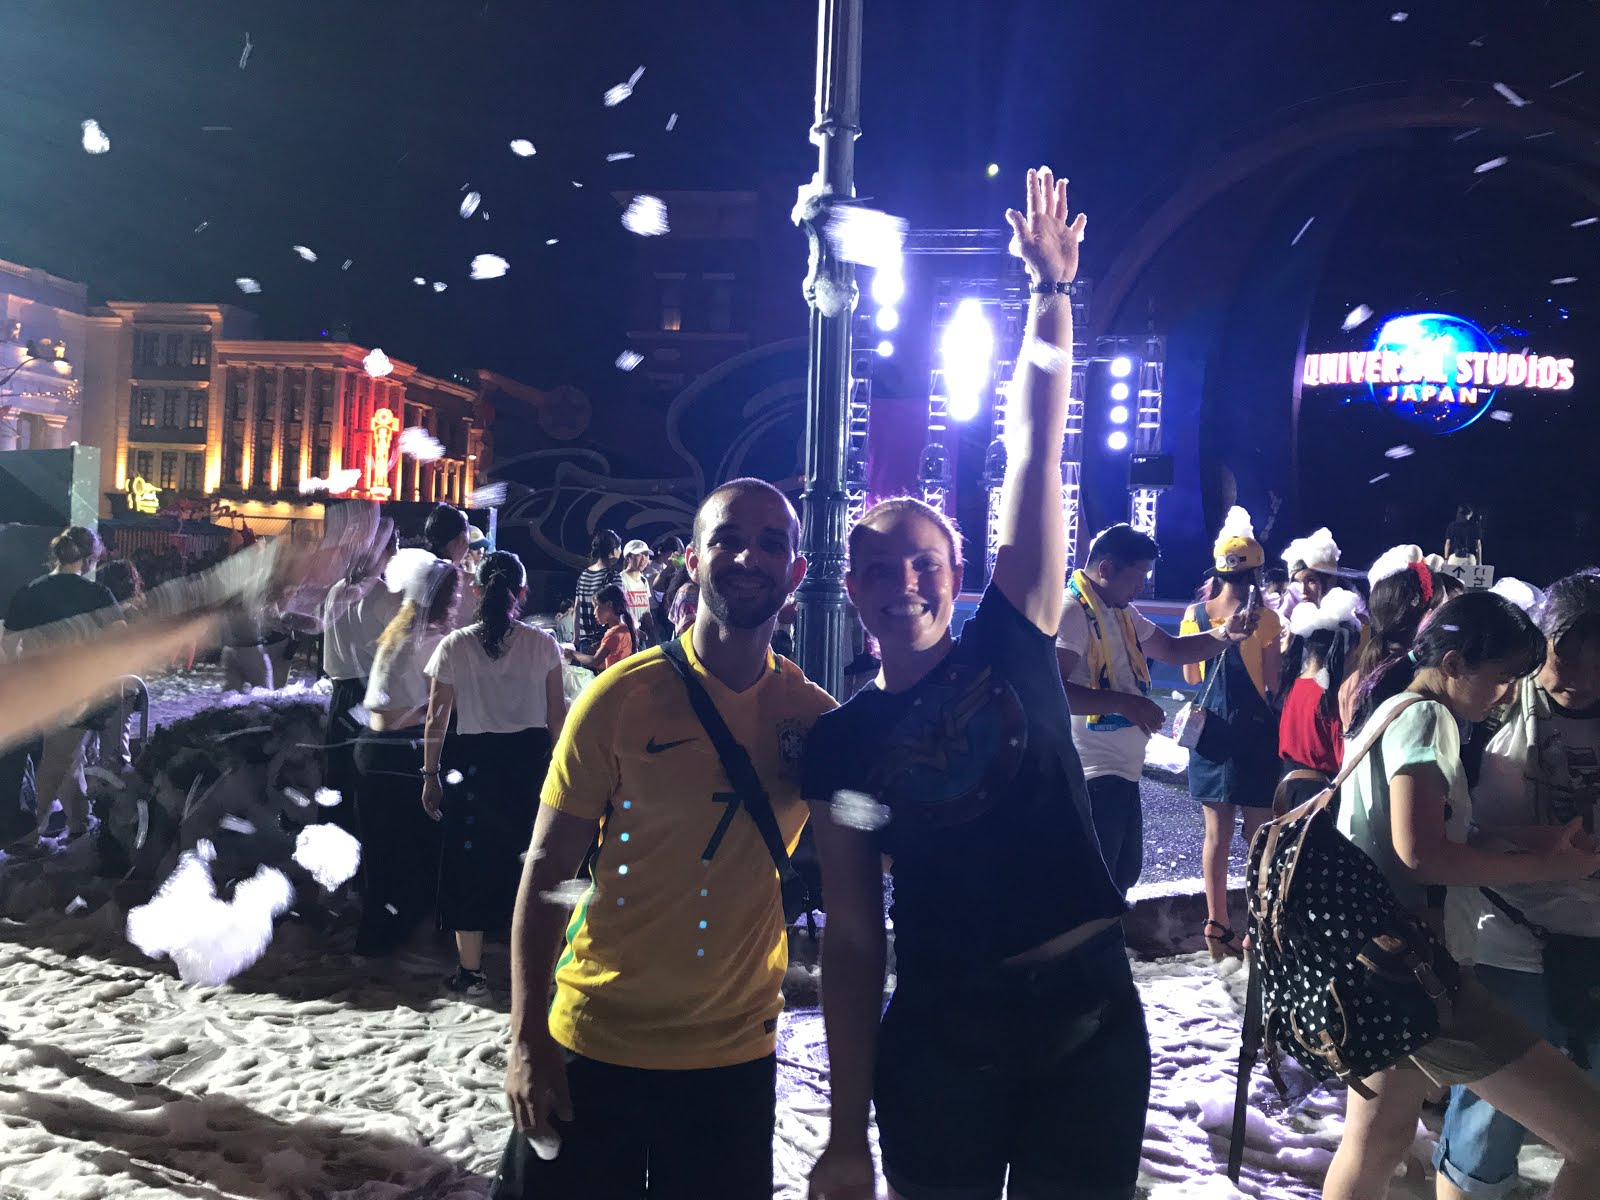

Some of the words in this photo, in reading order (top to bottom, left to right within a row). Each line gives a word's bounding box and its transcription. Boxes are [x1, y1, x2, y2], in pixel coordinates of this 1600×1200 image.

[1303, 350, 1447, 386] UNIVERSAL
[1456, 352, 1574, 390] STUDIOS
[1388, 385, 1477, 404] JAPAN
[702, 792, 742, 861] 7
